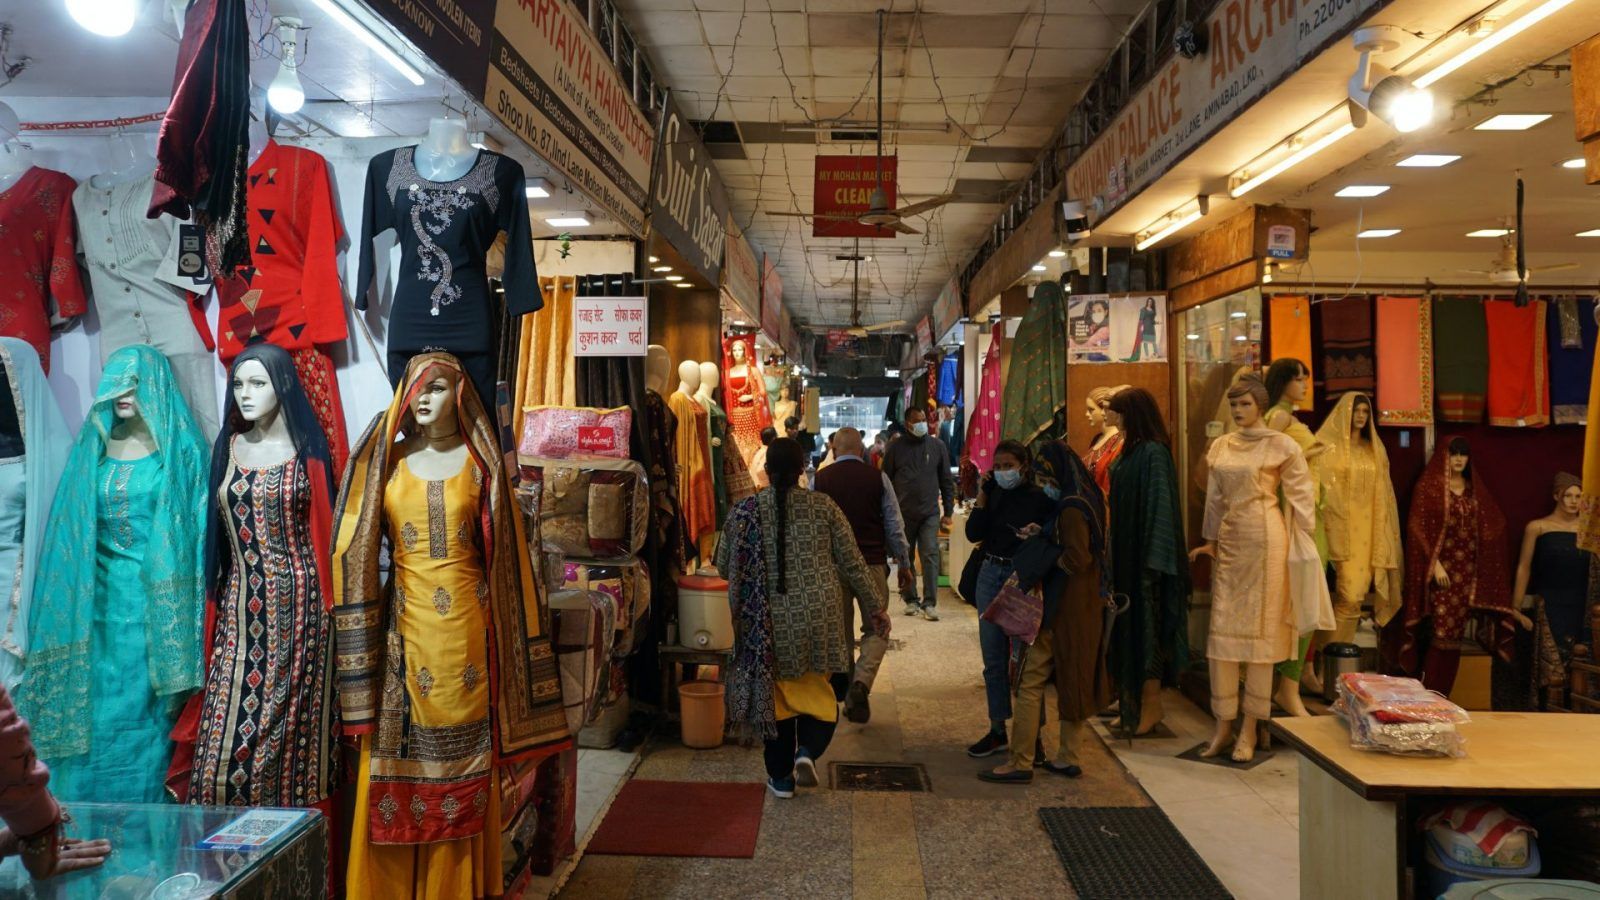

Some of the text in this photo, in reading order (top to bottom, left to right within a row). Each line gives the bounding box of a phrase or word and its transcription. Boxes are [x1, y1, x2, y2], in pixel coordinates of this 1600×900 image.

[464, 14, 482, 47] ITEMS
[500, 46, 541, 101] Bedsheets
[518, 0, 651, 165] ARTAVYA HANDLOOM
[1119, 61, 1183, 166] PALACE
[498, 88, 523, 130] Shop
[567, 151, 584, 183] Lane
[657, 112, 725, 270] Suit Sagar
